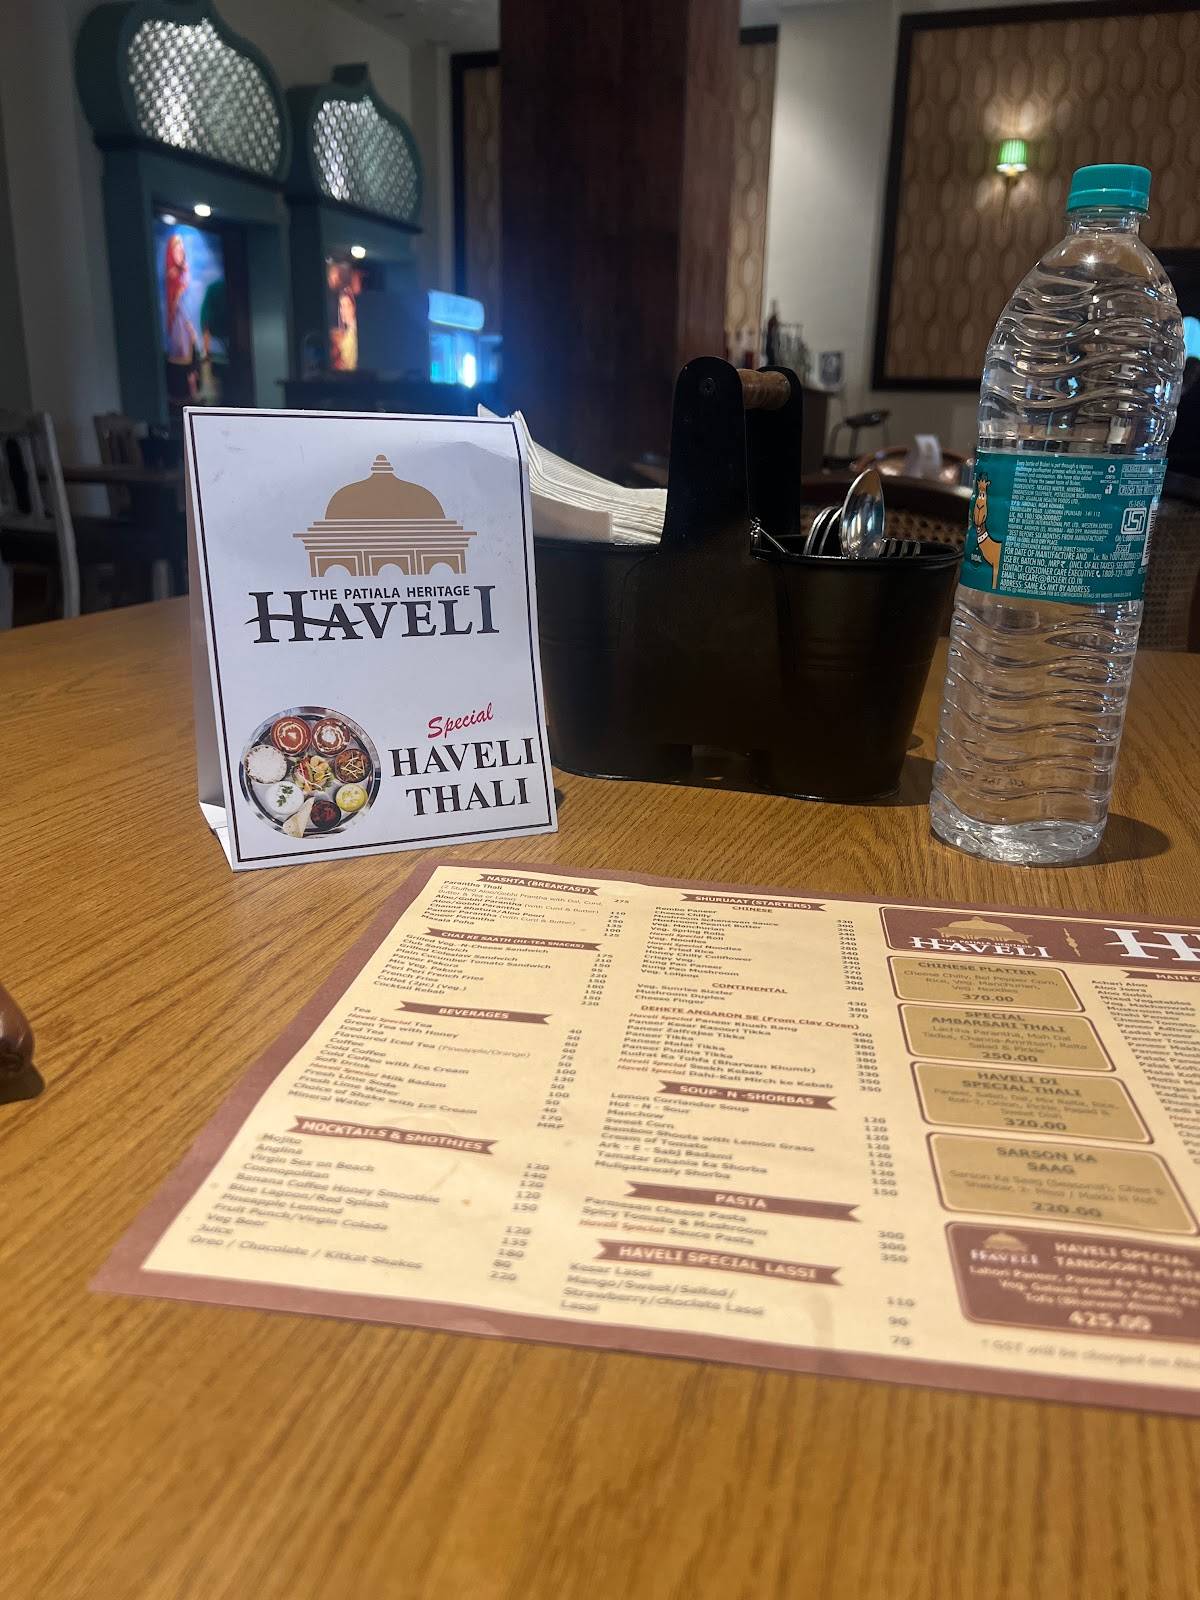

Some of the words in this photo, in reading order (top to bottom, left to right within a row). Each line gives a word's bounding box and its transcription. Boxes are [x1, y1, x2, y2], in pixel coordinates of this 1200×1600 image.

[1020, 557, 1036, 565] BATCH
[1036, 551, 1075, 560] MANUFACTURE
[1025, 566, 1053, 575] CUSTOMER
[1068, 569, 1095, 577] EXECUTIVE
[310, 588, 337, 601] THE
[344, 587, 401, 599] PATIALA
[407, 585, 471, 598] HERITAGE
[244, 585, 500, 644] HAVELI
[427, 702, 493, 740] Special
[389, 737, 538, 778] HAVELI
[406, 778, 530, 817] THALI
[488, 876, 525, 885] NASHTA
[528, 881, 591, 894] (BREAKFAST)
[695, 896, 748, 904] SHURUAAT
[751, 900, 811, 909] (STARTERS)
[481, 935, 511, 943] SAATH
[908, 936, 1053, 958] HAVELI
[918, 962, 976, 971] CHINESE
[980, 967, 1036, 975] PLATTER
[712, 983, 788, 993] CONTINENTAL
[962, 994, 1014, 1002] 370.00
[439, 1008, 508, 1019] BEVERAGES
[641, 1005, 684, 1013] DEHKTE
[687, 1009, 742, 1019] ANGARON
[762, 1016, 795, 1024] (From
[966, 1012, 1025, 1021] SPECIAL
[931, 1017, 1016, 1029] AMBARSARI
[1023, 1023, 1065, 1032] THALI
[982, 1052, 1037, 1062] 250.00
[977, 1073, 1034, 1084] HAVELI
[1040, 1077, 1057, 1085] DI
[962, 1081, 1029, 1092] SPECIAL
[1032, 1087, 1081, 1096] THALI
[1005, 1118, 1066, 1130] 320.00
[302, 1121, 387, 1137] MOCKTAILS
[390, 1130, 400, 1138] &
[406, 1132, 483, 1150] SMOTHIES
[997, 1147, 1068, 1161] SARSON
[1073, 1152, 1097, 1163] KA
[1027, 1162, 1075, 1174] SAAG
[715, 1194, 767, 1208] PASTA
[1032, 1202, 1102, 1218] 220.00
[1055, 1242, 1118, 1257] HAVELI
[619, 1246, 682, 1261] HAVELI
[687, 1252, 760, 1270] SPECIAL
[765, 1263, 816, 1279] LASSI
[970, 1249, 1039, 1266] HAVELI
